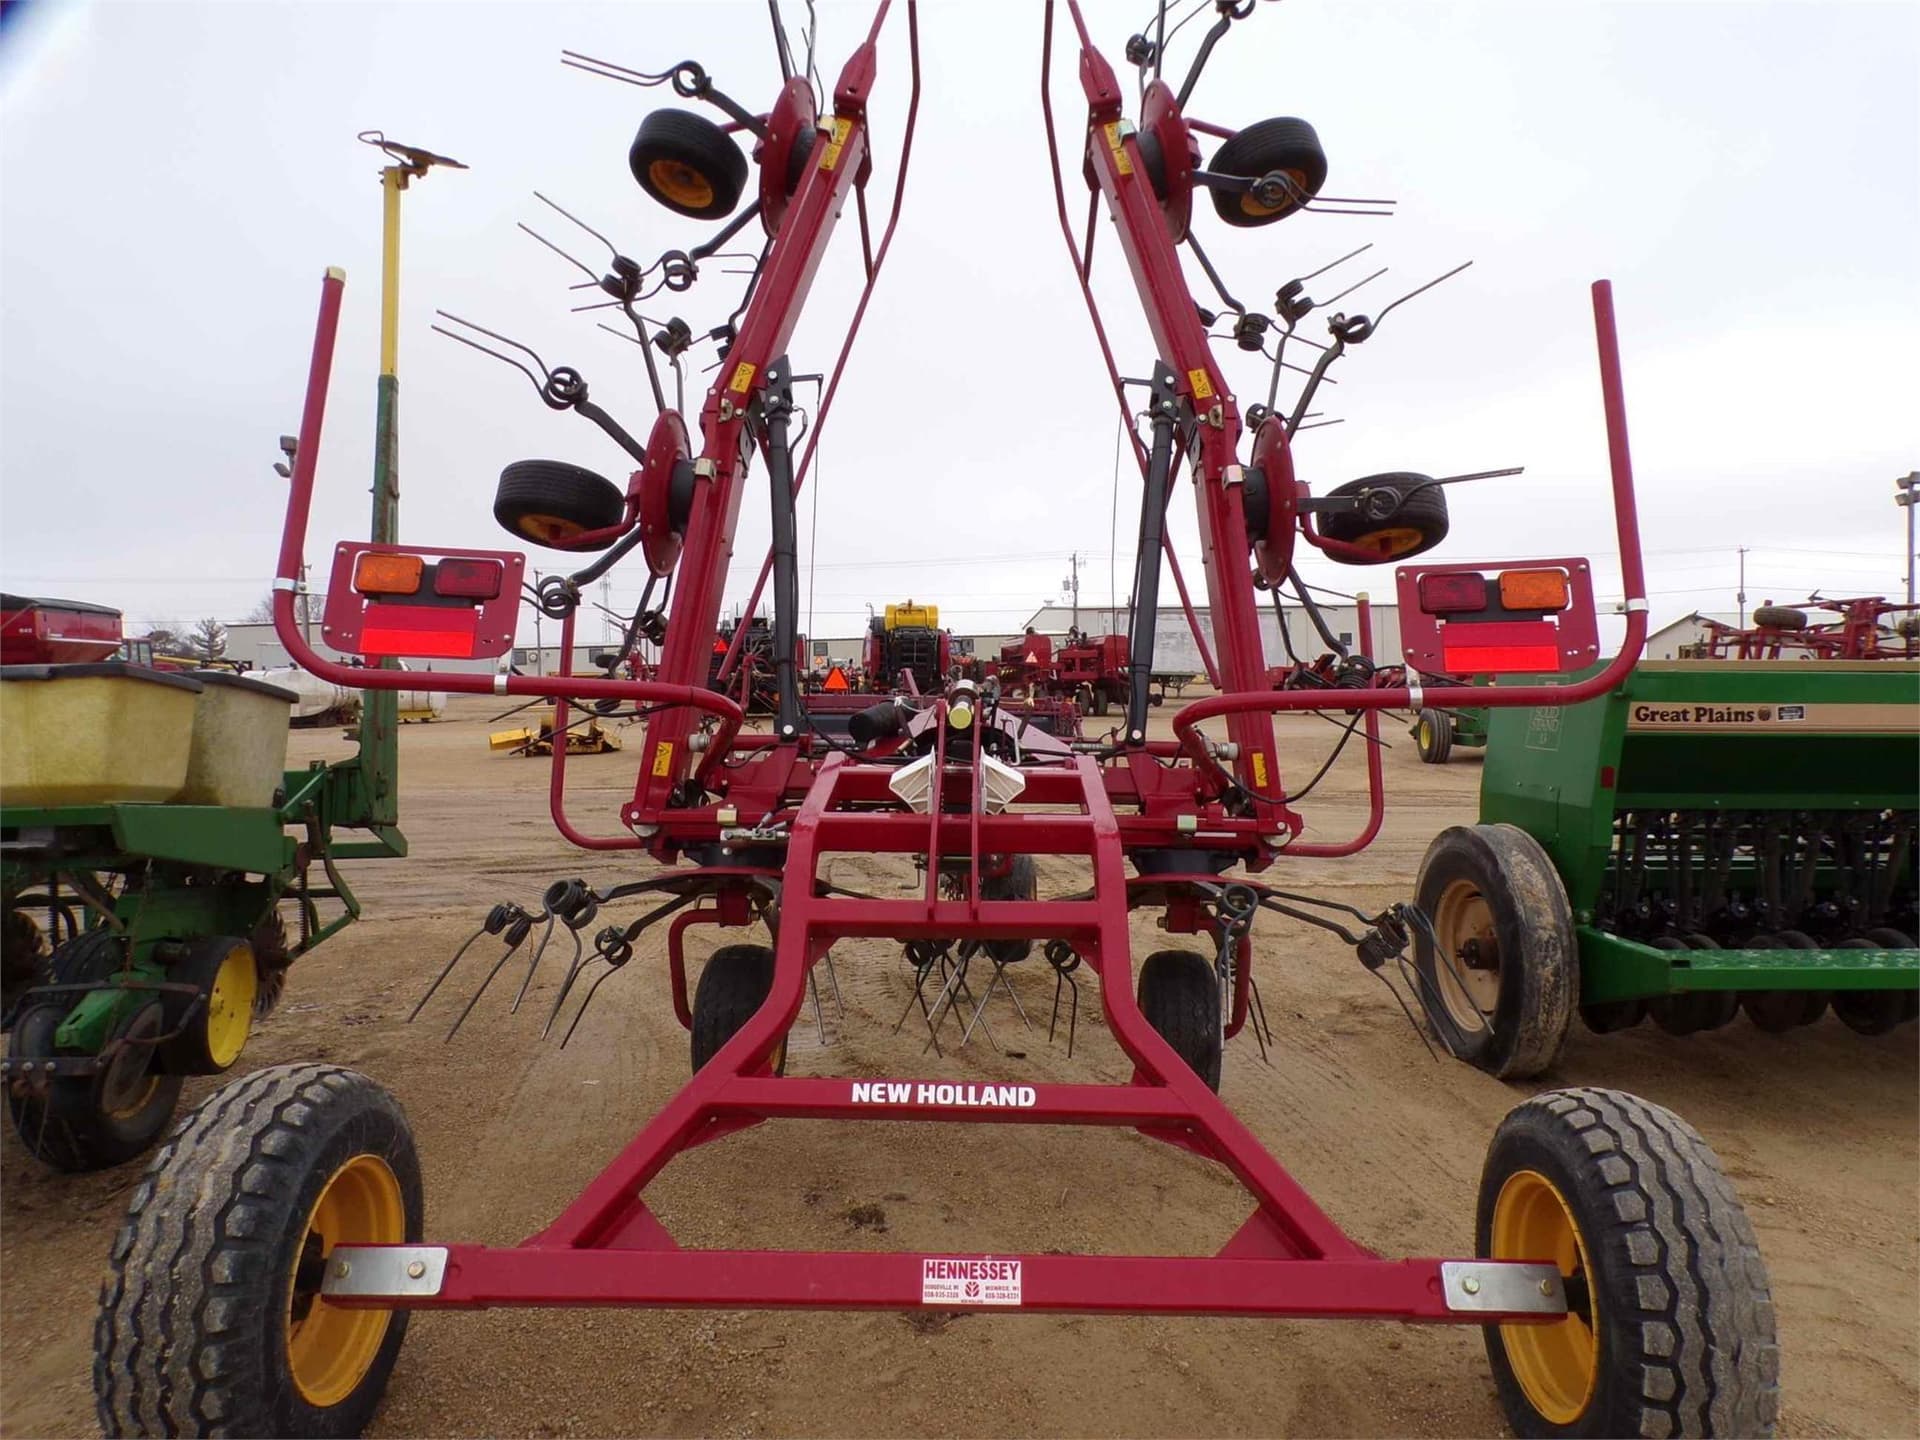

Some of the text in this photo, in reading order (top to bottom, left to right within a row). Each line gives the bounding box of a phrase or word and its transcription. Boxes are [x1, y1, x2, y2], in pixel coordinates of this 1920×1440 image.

[1635, 706, 1754, 723] Great Plains
[851, 1083, 1037, 1107] NEW HOLLAND
[925, 1261, 1019, 1280] HENNESSEY
